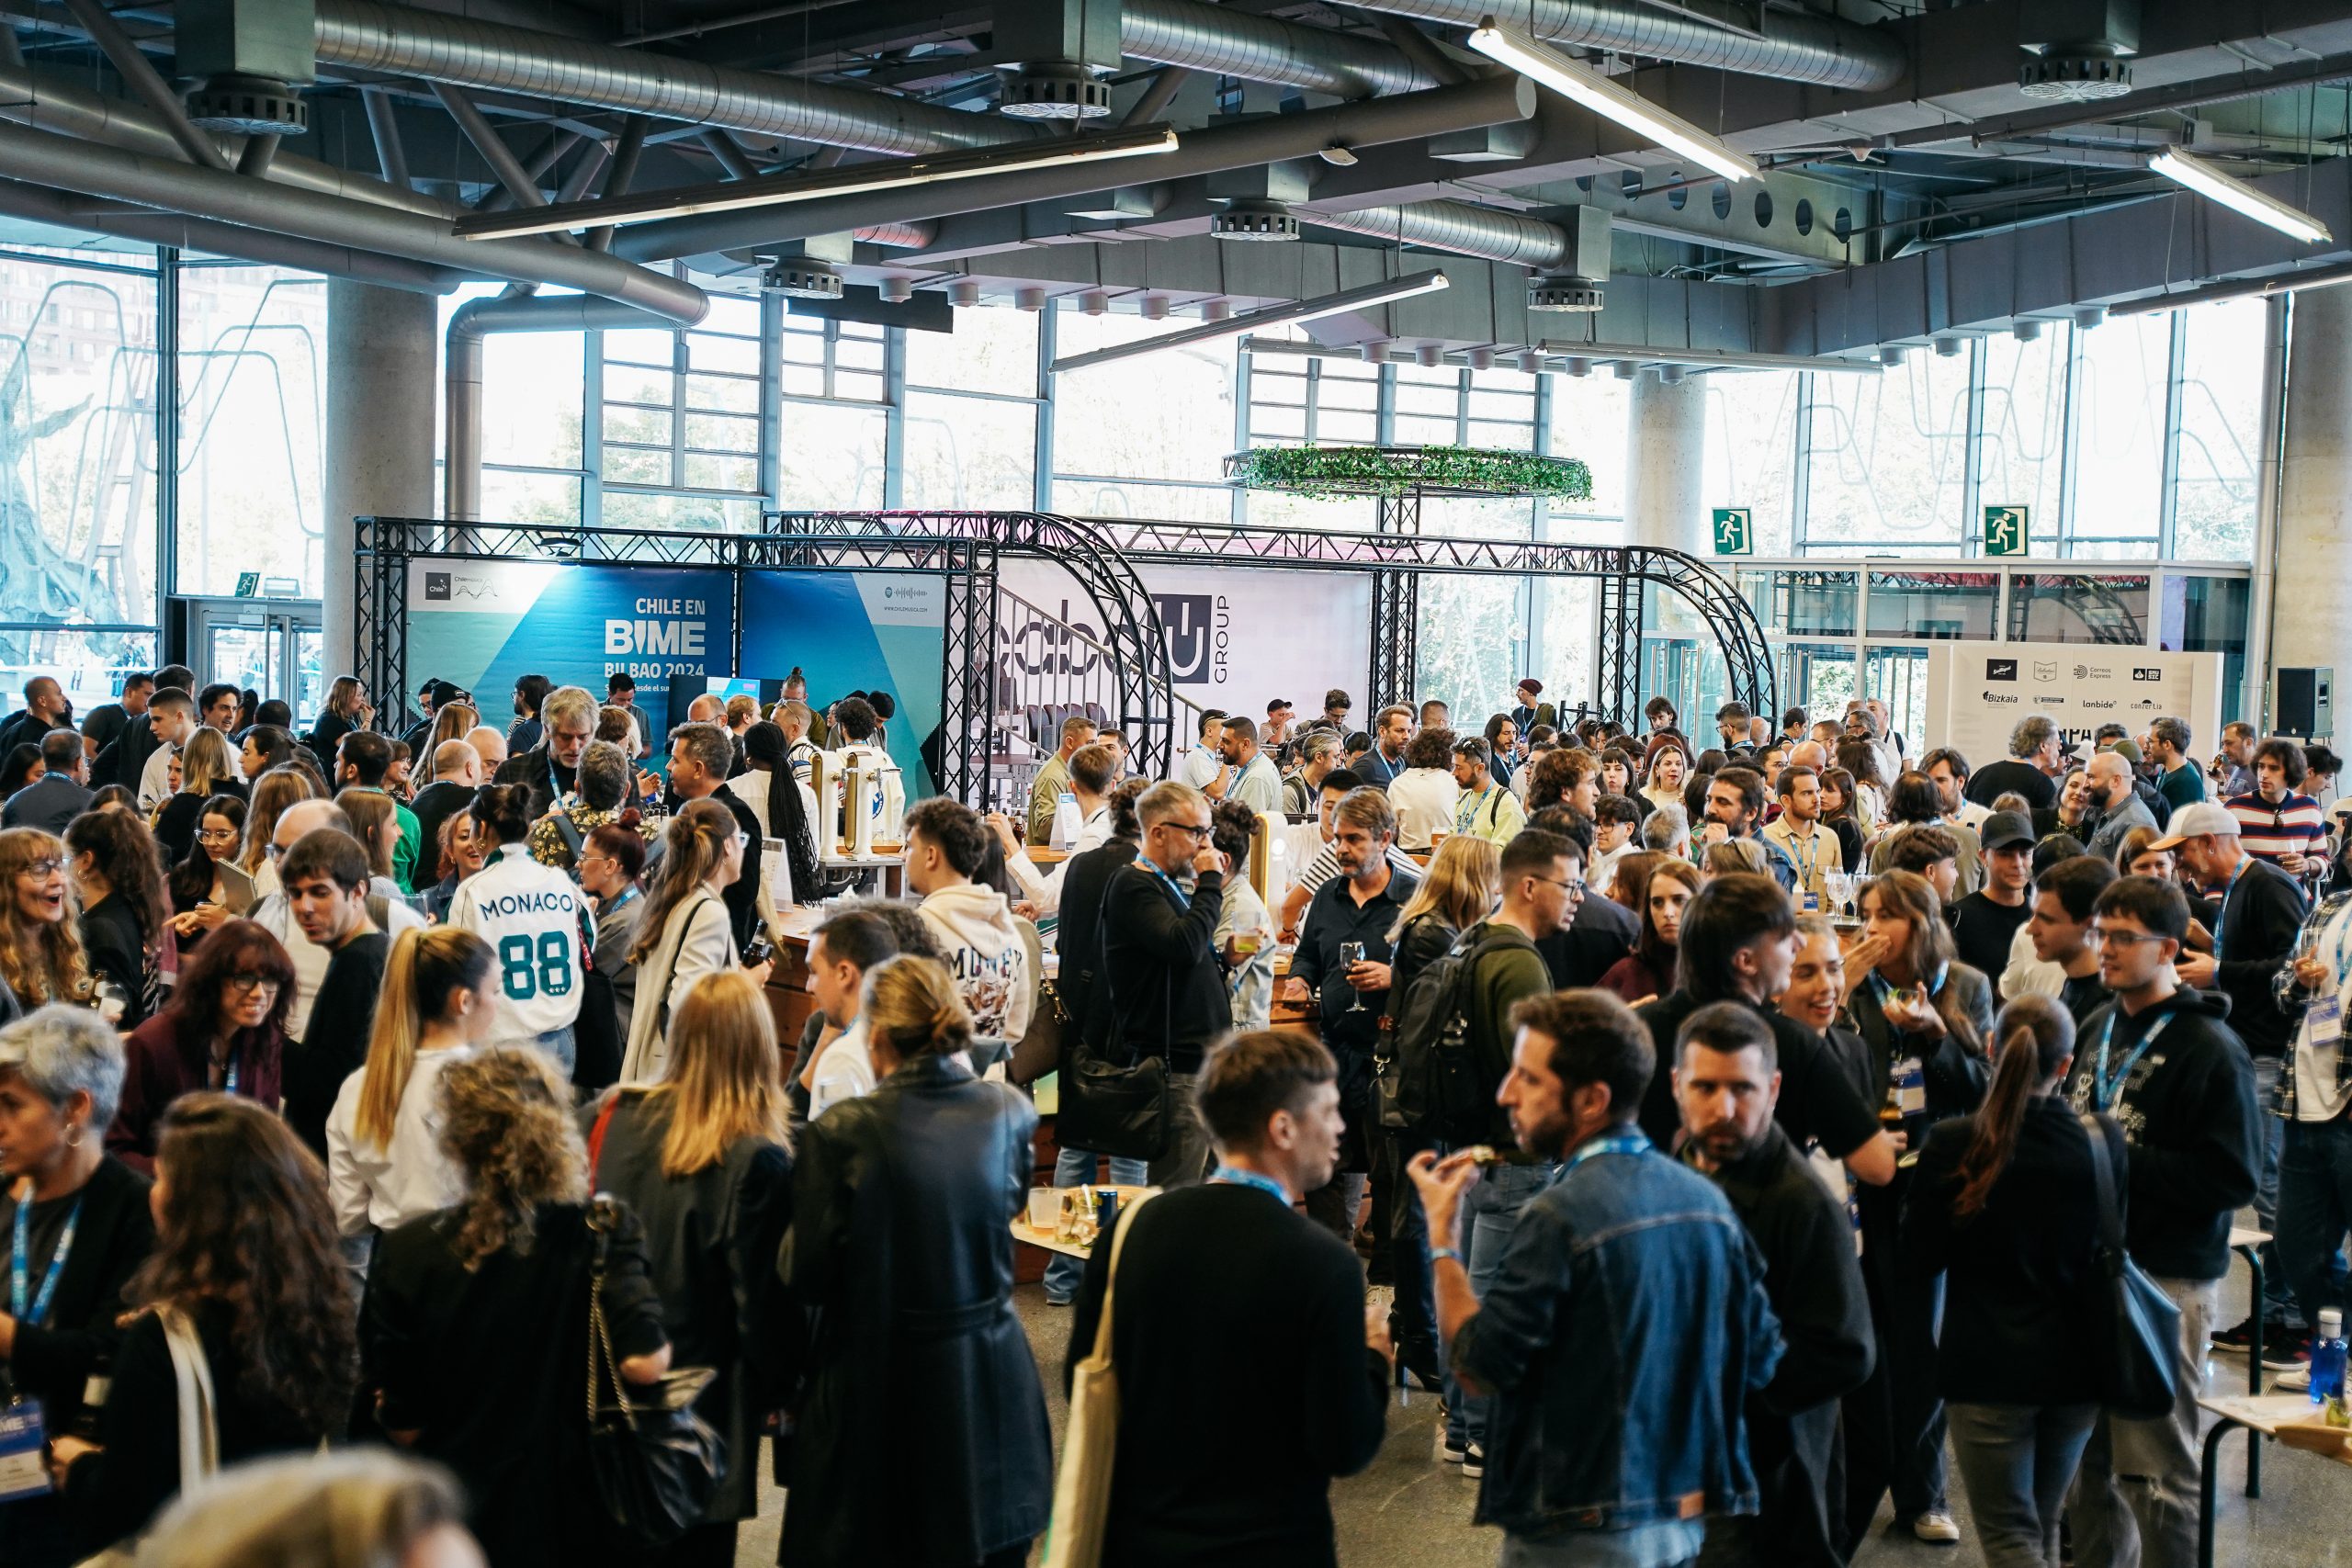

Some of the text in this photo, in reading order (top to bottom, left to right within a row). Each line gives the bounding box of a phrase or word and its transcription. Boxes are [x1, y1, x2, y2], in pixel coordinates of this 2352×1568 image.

[635, 598, 706, 615] CHILE EN
[605, 619, 706, 656] BIME
[1214, 594, 1230, 684] GROUP
[664, 662, 706, 679] 2024
[1987, 694, 2018, 704] Bizkaia
[2082, 700, 2114, 709] lanbide
[480, 892, 573, 921] MONACO
[498, 930, 571, 1000] 88
